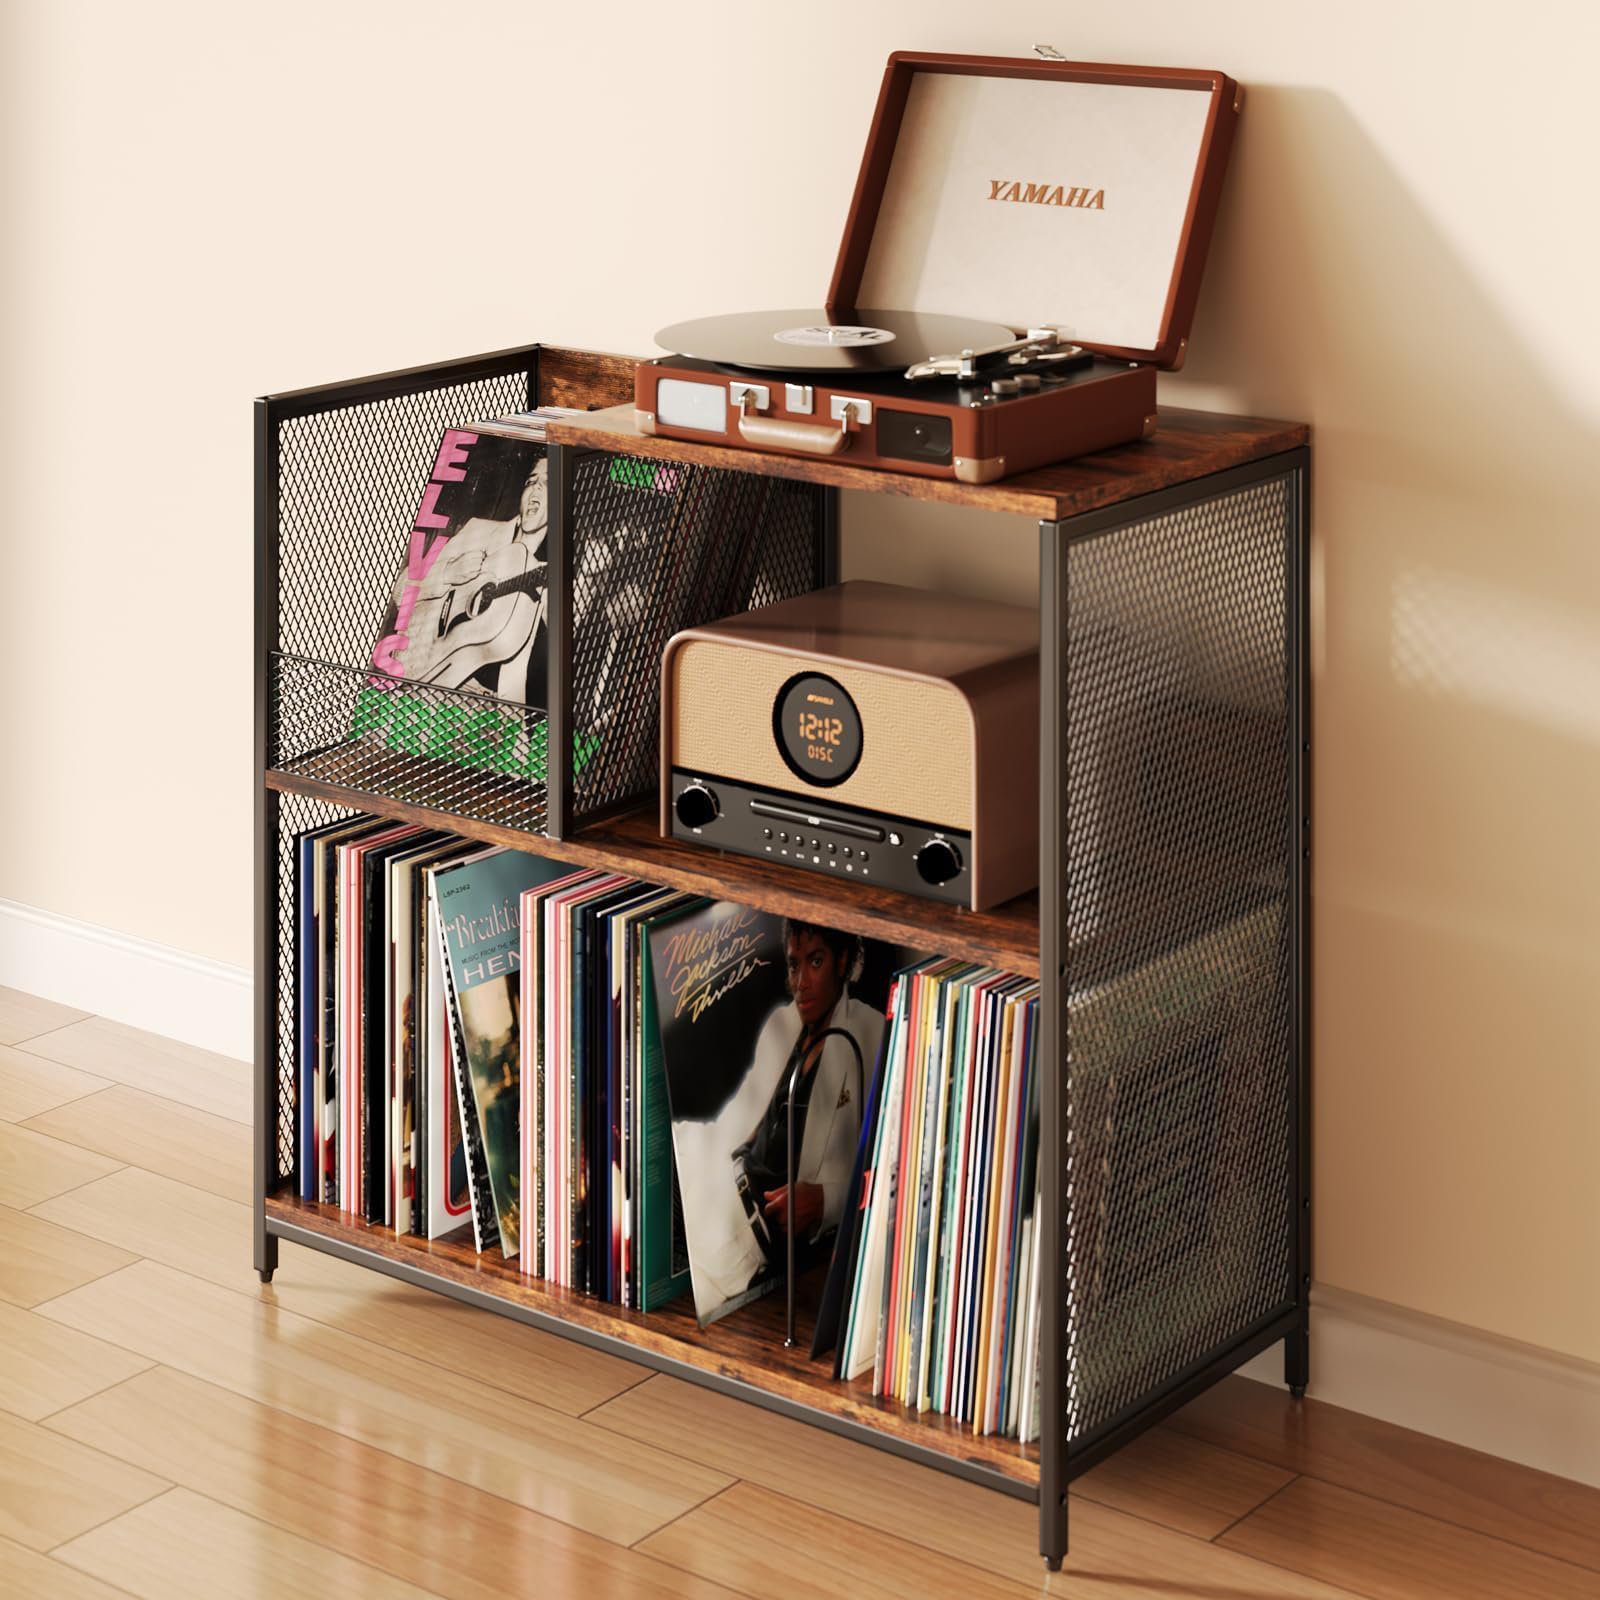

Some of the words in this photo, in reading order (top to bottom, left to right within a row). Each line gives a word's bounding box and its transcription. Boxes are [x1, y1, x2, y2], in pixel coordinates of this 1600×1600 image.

[988, 179, 1105, 210] YAMAHA
[368, 428, 480, 691] ELVIS
[799, 712, 843, 746] 12:12
[671, 932, 765, 1018] Jackson
[688, 957, 771, 1024] Thriller
